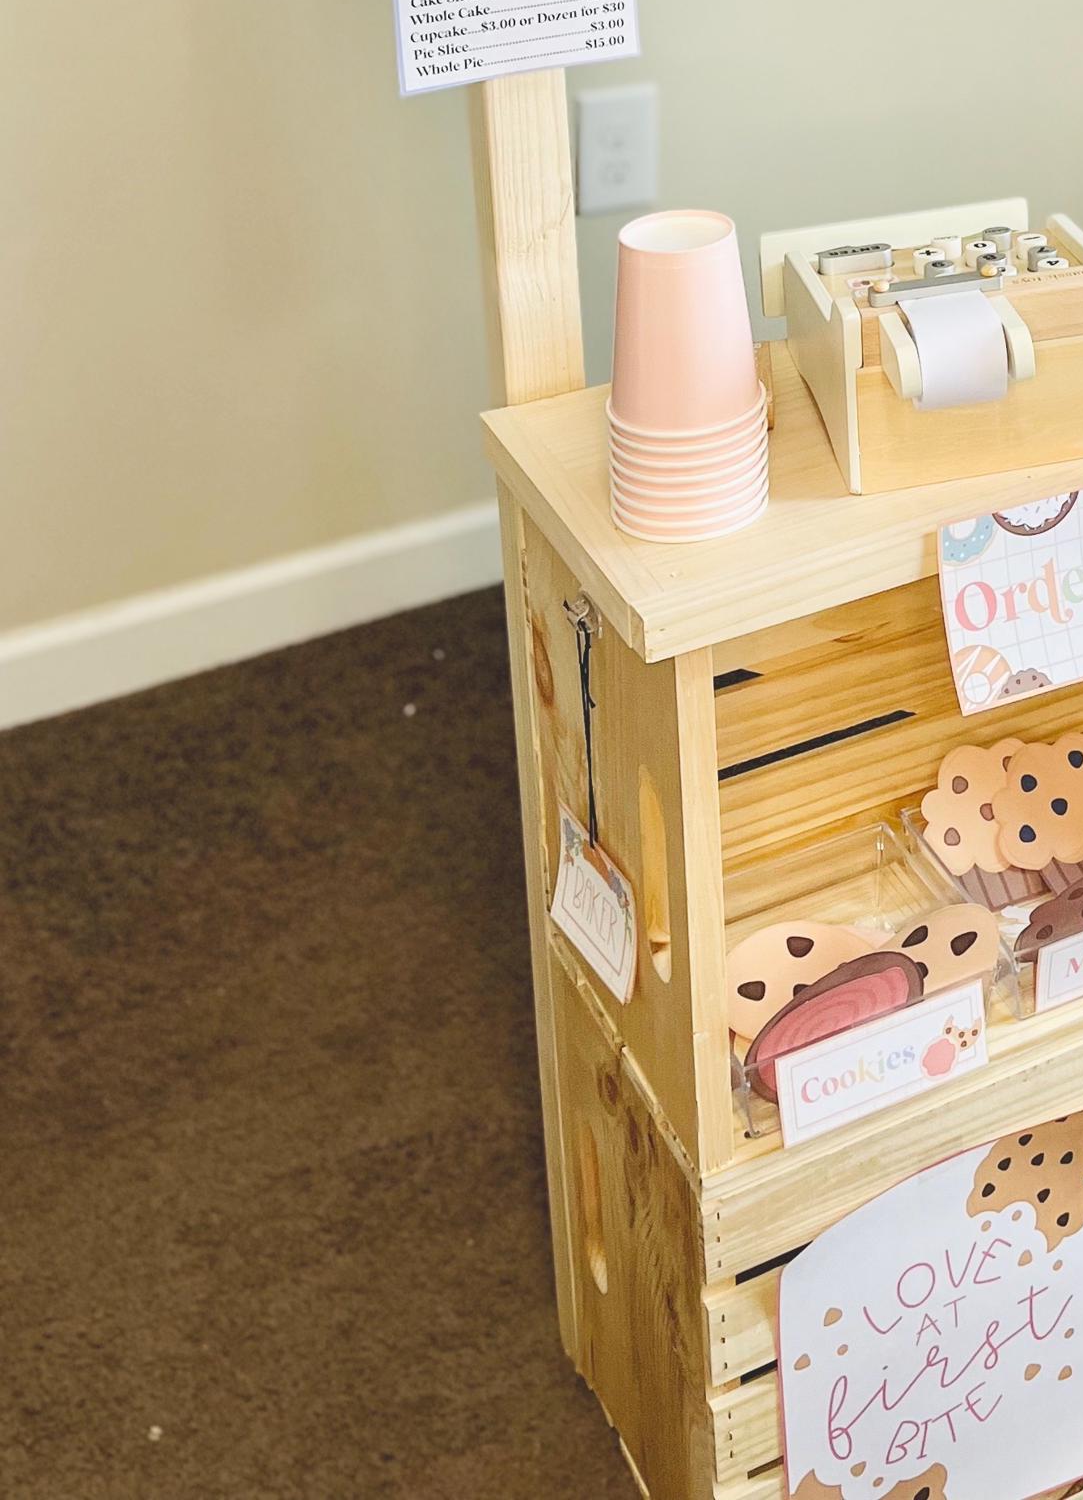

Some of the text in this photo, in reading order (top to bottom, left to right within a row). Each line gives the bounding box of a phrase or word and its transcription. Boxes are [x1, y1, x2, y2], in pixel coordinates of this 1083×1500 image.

[410, 10, 455, 26] Whole
[519, 16, 534, 27] or
[536, 10, 578, 24] Dozen
[581, 5, 600, 18] for
[602, 1, 625, 14] $30
[415, 63, 461, 78] Whole
[800, 1045, 916, 1103] Cookies
[863, 1238, 1012, 1335] LOVE
[915, 1295, 967, 1346] AT
[828, 1285, 1074, 1460] first
[885, 1381, 1002, 1465] BITE
